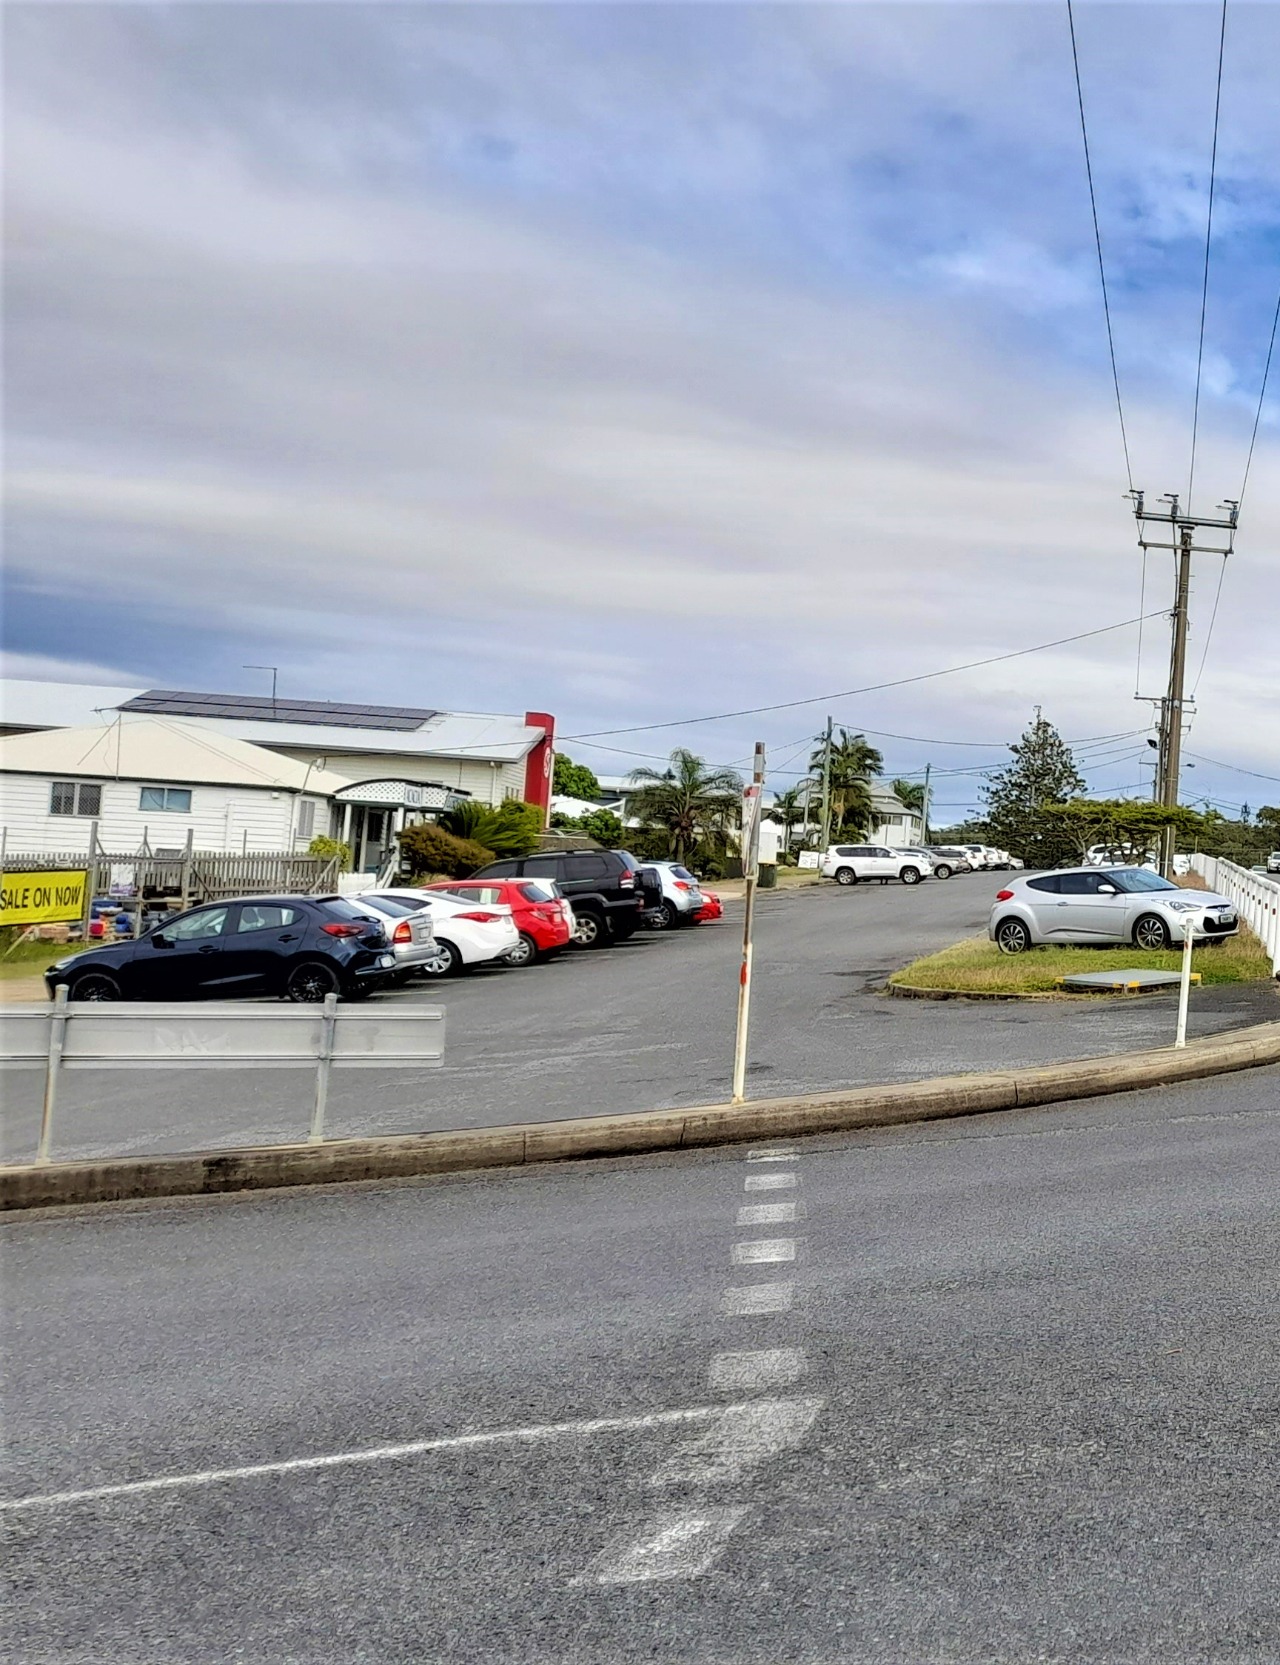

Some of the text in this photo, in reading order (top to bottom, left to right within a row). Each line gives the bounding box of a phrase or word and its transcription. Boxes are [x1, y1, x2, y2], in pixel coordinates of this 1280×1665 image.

[0, 886, 81, 910] SALE ON NOW
